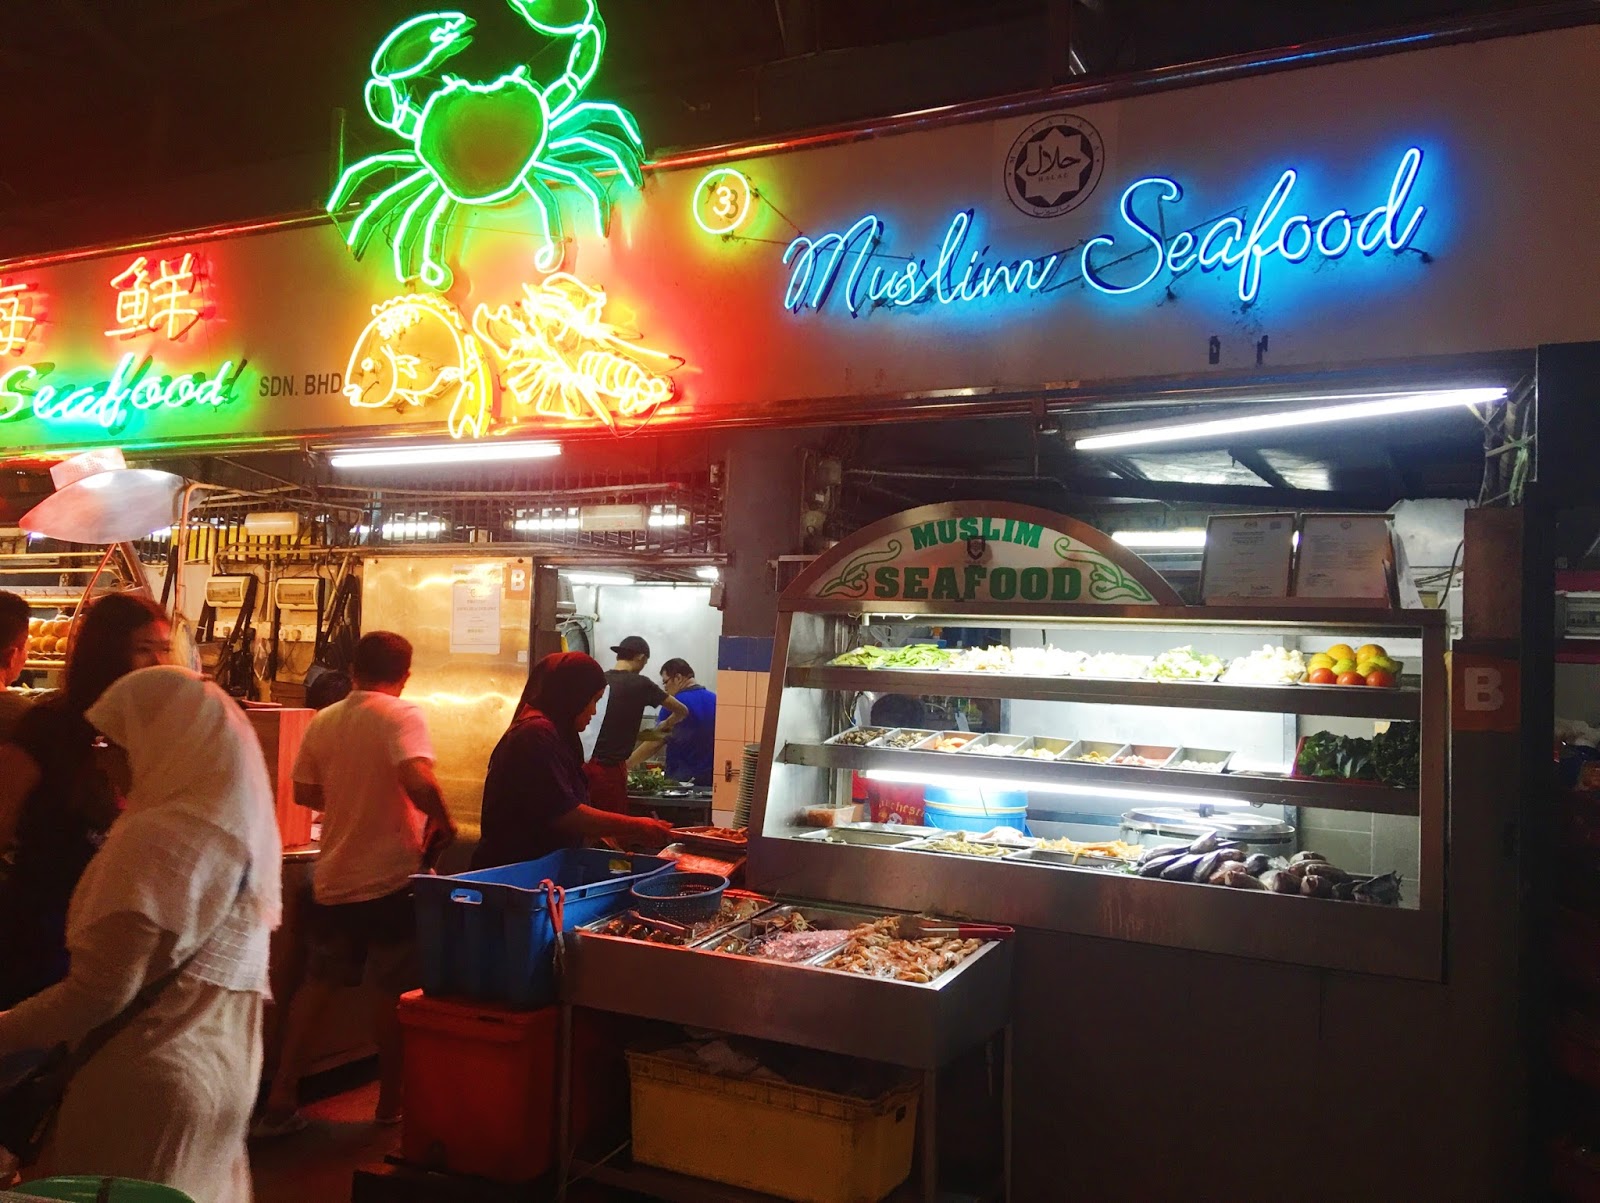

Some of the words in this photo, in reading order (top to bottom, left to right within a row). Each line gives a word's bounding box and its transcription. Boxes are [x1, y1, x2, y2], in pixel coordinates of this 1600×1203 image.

[783, 210, 1058, 313] Muslim
[1081, 147, 1425, 302] Seafood
[0, 353, 235, 427] Seafood
[259, 375, 298, 397] SDN.
[304, 373, 342, 395] BHD
[910, 517, 1044, 551] MUSLIM
[510, 569, 526, 591] B
[874, 565, 1082, 600] SEAFOOD
[1463, 667, 1504, 711] B
